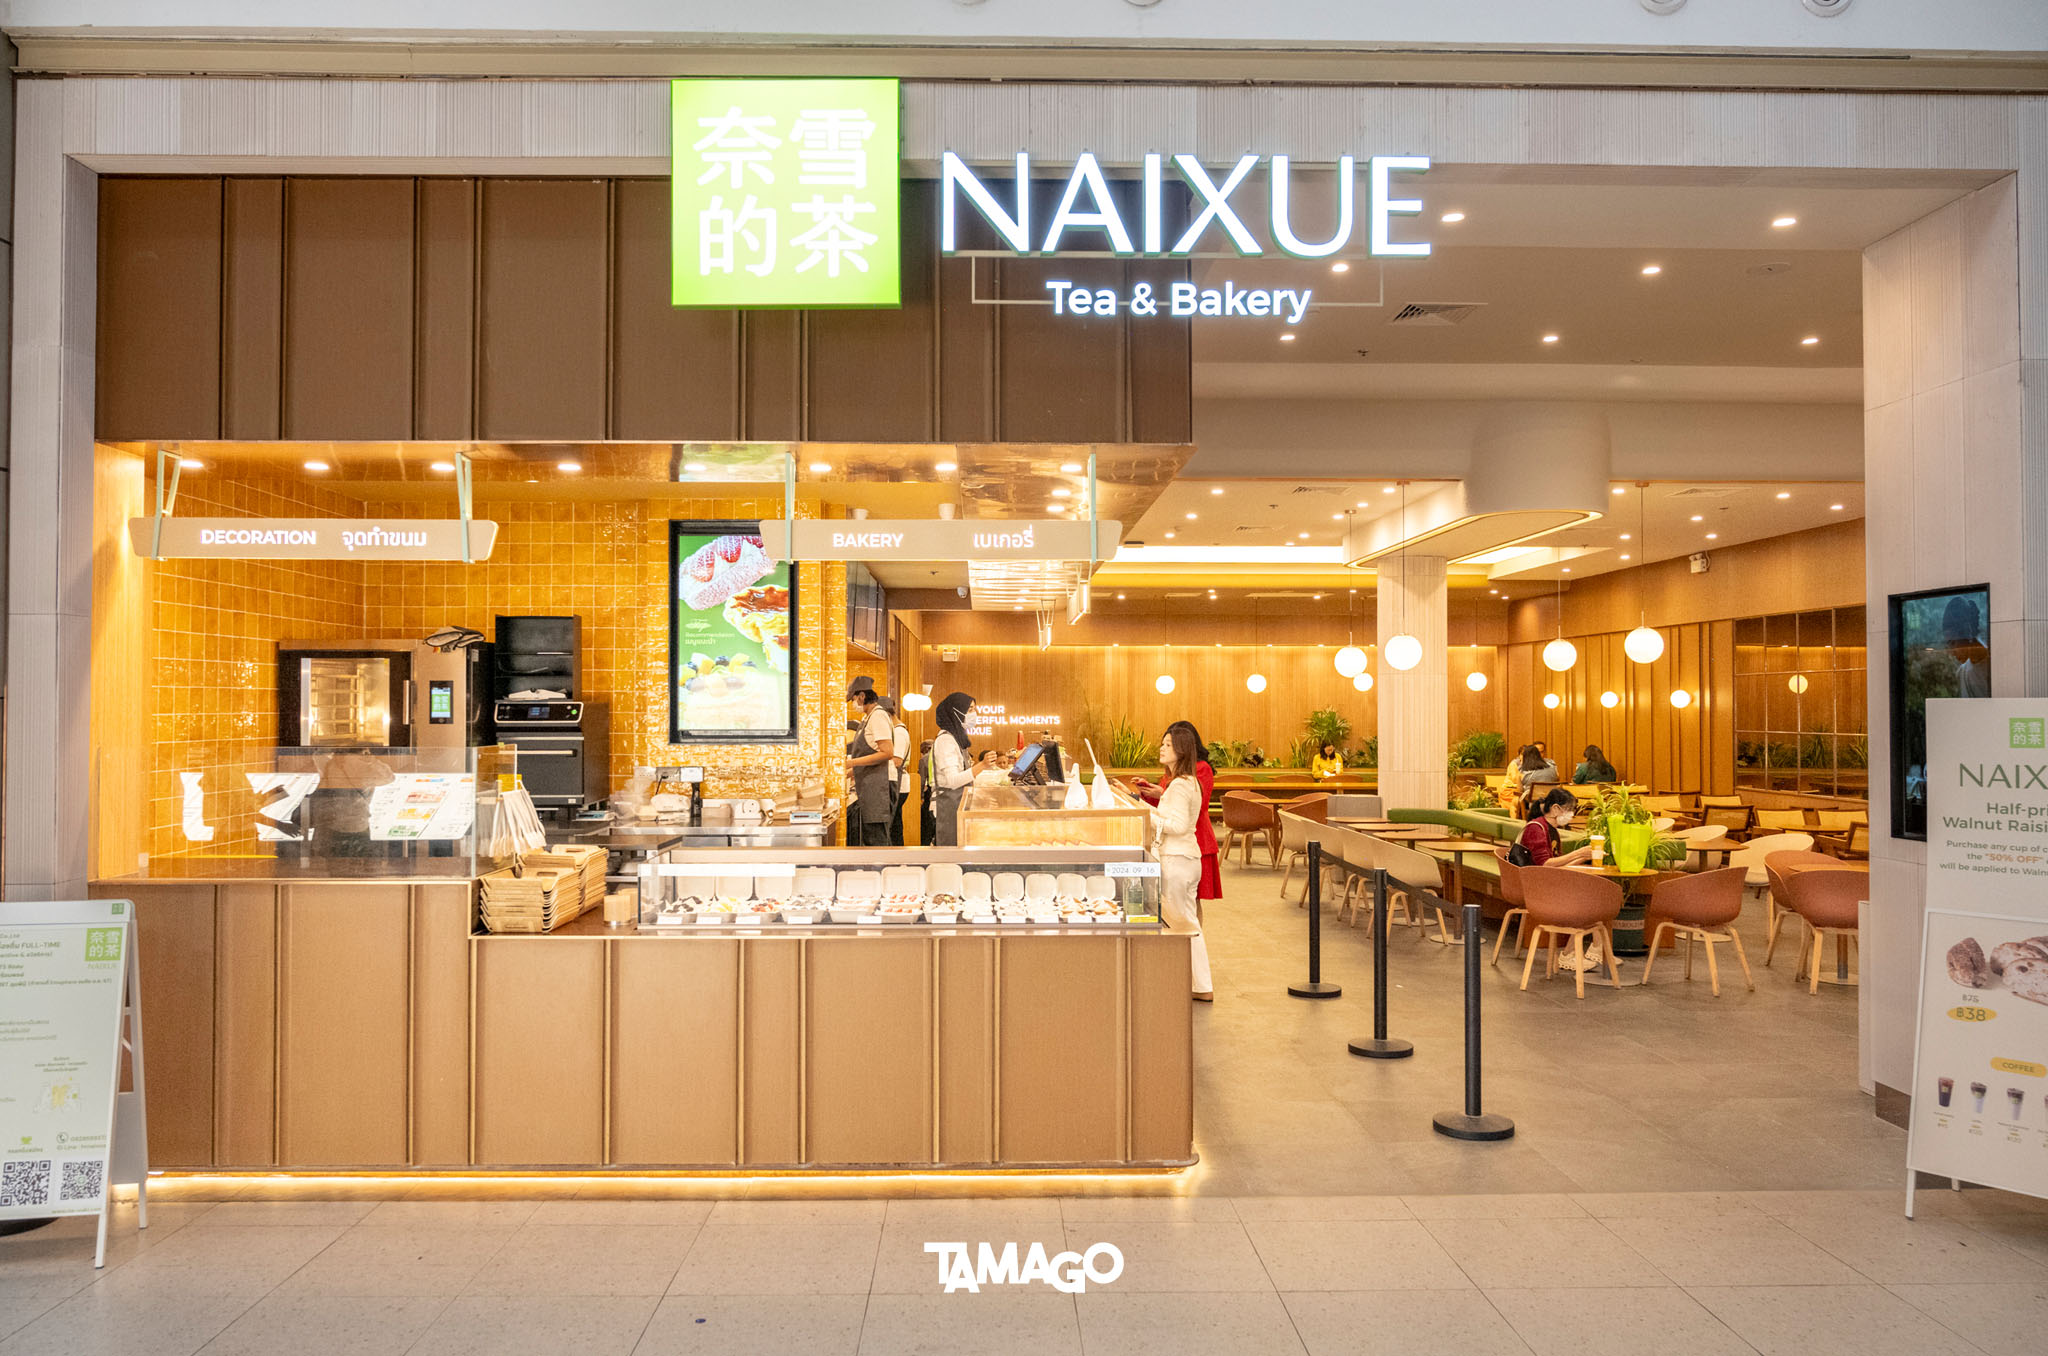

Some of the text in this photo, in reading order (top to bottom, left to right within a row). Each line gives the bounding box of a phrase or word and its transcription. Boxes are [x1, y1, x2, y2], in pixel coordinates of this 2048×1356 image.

[693, 105, 877, 189] 奈雪
[942, 151, 1432, 257] NAIXUE
[698, 194, 879, 278] 的茶
[1046, 281, 1312, 323] Tea & Bakery
[200, 530, 317, 545] DECORATION
[342, 526, 427, 551] จุดทำขนม
[832, 533, 904, 548] BAKERY
[973, 524, 1034, 548] เบเกอรี่
[976, 705, 1005, 714] YOUR
[1010, 716, 1061, 725] MOMENTS
[1960, 763, 2048, 790] NAIX
[1942, 816, 2048, 833] Walnut Raisi
[1946, 840, 1989, 849] Purchase
[1990, 844, 2008, 852] any
[2009, 845, 2028, 854] cup
[1958, 863, 1970, 871] be
[1972, 865, 2007, 874] applied
[2010, 867, 2020, 875] to
[2022, 868, 2048, 877] Waln
[2002, 1062, 2035, 1073] COFFEE
